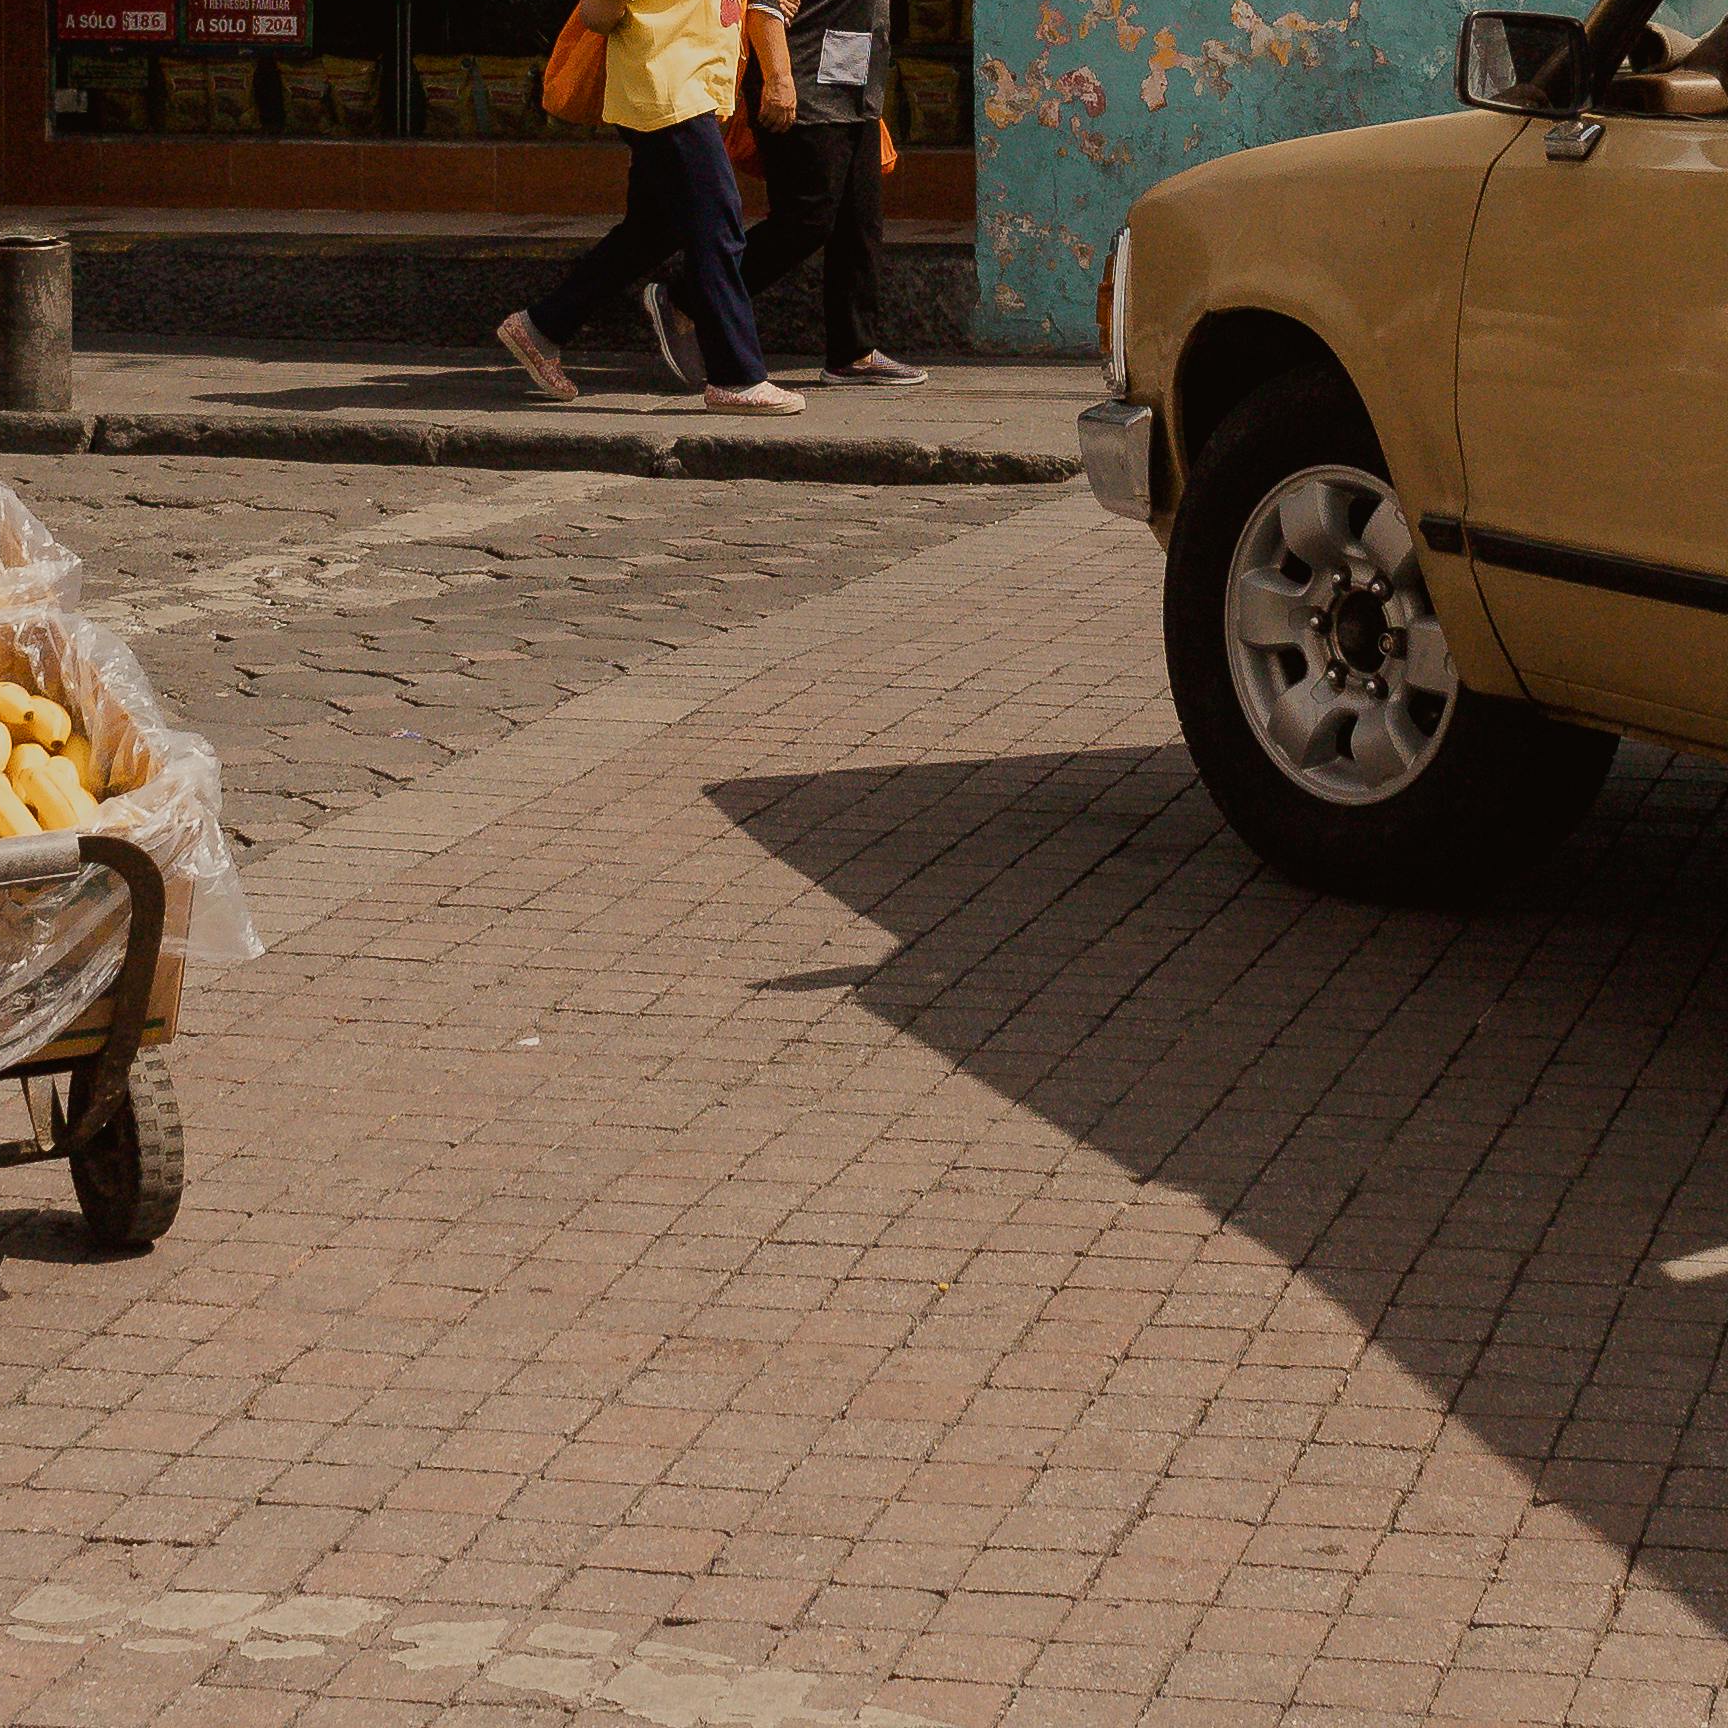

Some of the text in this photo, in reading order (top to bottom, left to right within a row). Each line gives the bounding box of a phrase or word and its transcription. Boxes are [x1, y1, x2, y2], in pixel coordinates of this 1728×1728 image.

[65, 9, 160, 29] A SÓLO $186
[195, 18, 206, 33] A
[209, 15, 246, 33] SÓLO
[266, 19, 293, 32] 204
